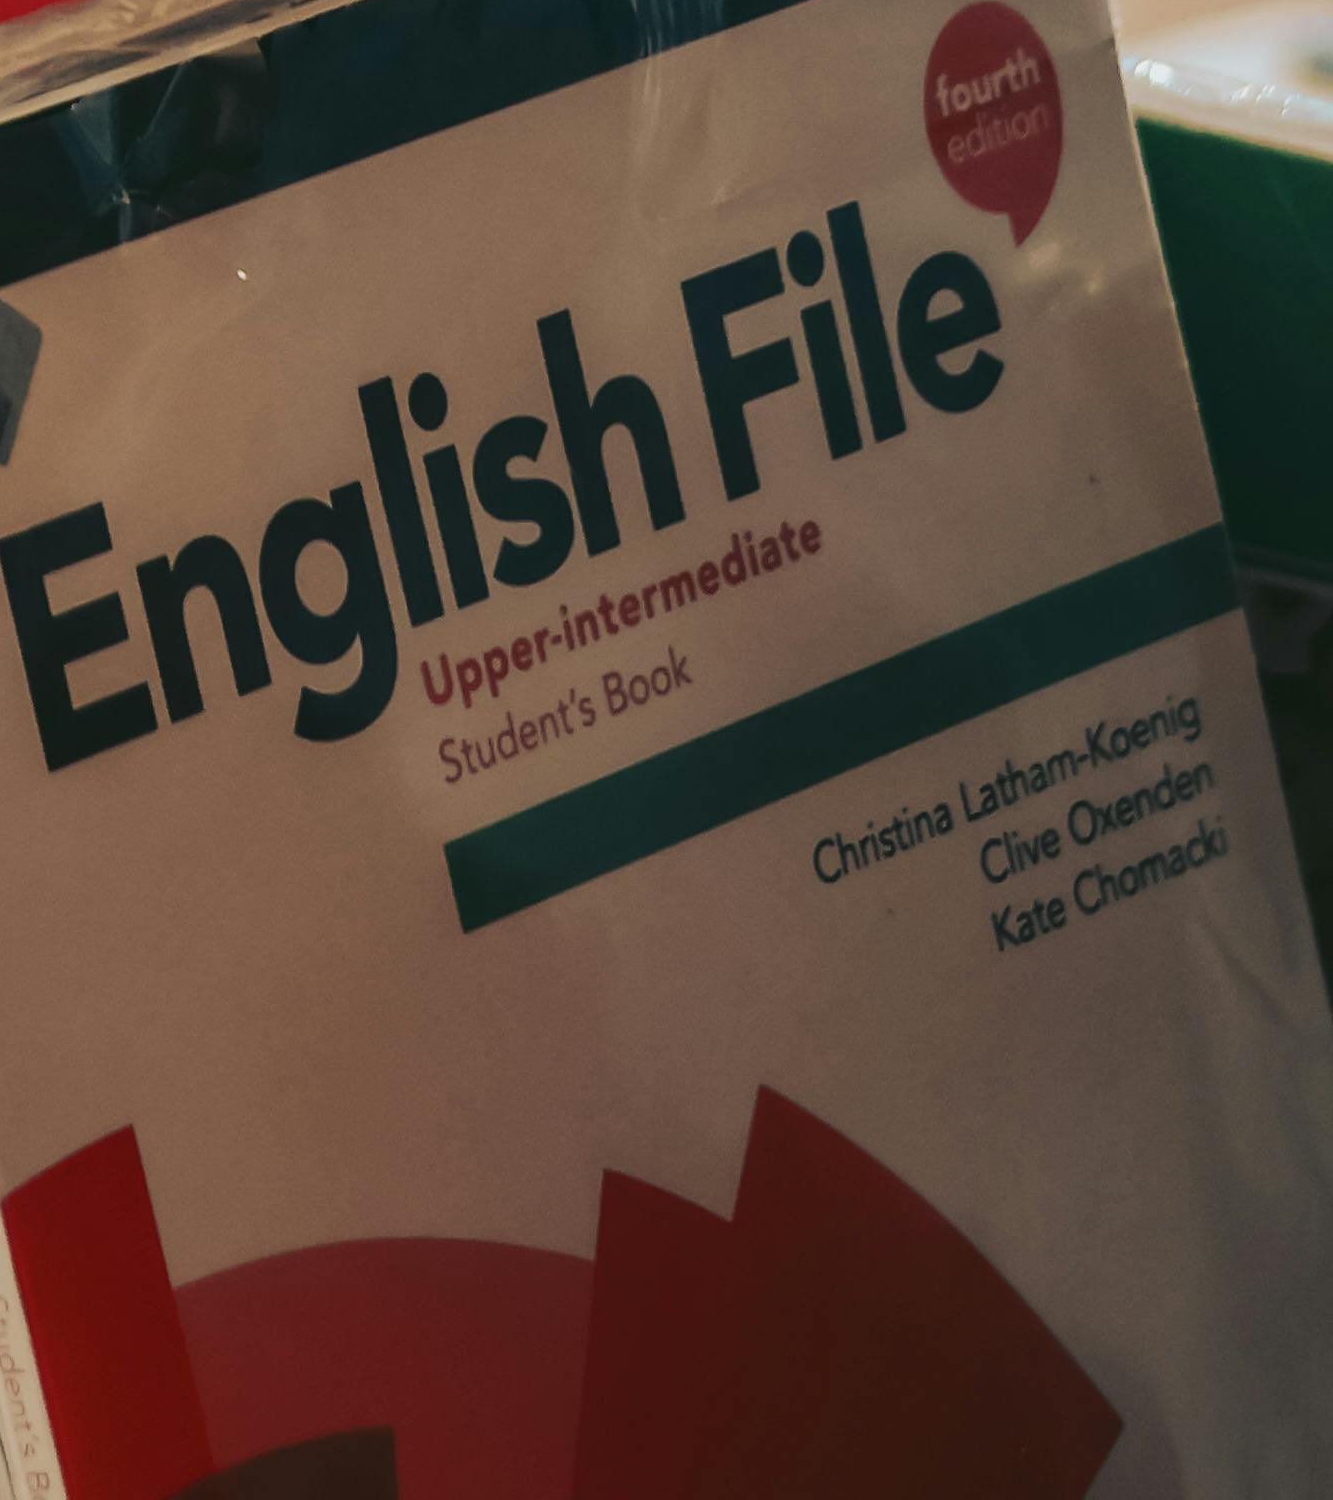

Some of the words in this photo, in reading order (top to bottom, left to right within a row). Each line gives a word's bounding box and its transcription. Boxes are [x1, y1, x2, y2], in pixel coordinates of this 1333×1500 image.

[933, 49, 1042, 118] fourth
[947, 98, 1052, 164] edition
[680, 199, 1006, 504] File
[420, 515, 824, 709] Upper-intermediate
[437, 688, 600, 786] Student's
[604, 645, 694, 719] Book
[811, 796, 956, 887] Christina
[961, 693, 1204, 822] Latham-Koenig
[979, 818, 1063, 887] Clive
[1067, 756, 1217, 844] Oxenden
[990, 896, 1067, 954] Kate
[1071, 820, 1231, 916] Chomacki
